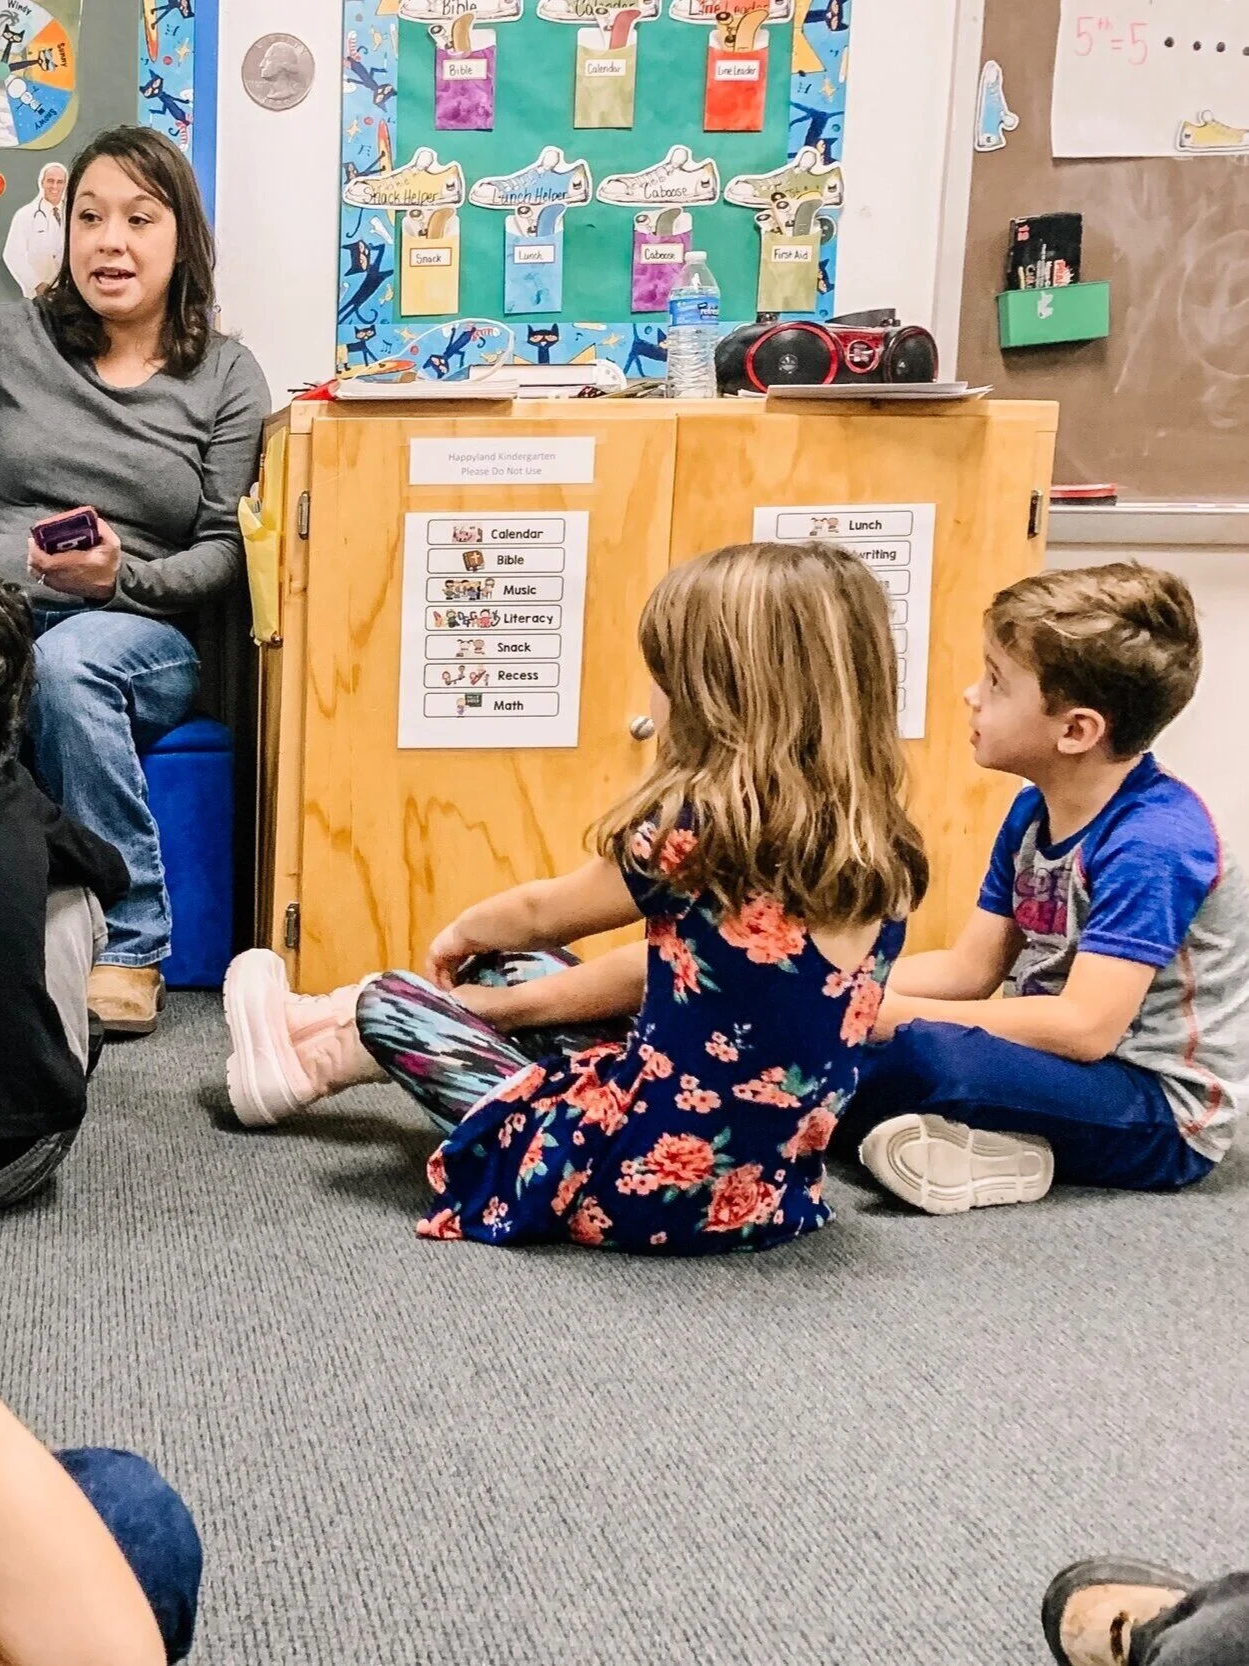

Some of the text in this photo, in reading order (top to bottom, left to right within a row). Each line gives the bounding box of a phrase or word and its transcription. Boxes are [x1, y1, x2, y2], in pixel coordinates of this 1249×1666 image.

[7, 0, 32, 16] Windy
[57, 42, 68, 68] Sunny
[449, 64, 473, 77] Bible
[587, 62, 622, 74] Calendar
[34, 108, 58, 130] Snowy
[363, 187, 439, 206] Snack Helper
[493, 187, 568, 204] Lunch Helper
[644, 182, 688, 199] Caboose
[415, 253, 442, 265] Snack
[518, 251, 543, 261] Lunch
[644, 248, 676, 260] Caboose
[774, 249, 809, 260] First Aid
[448, 451, 556, 463] Happyland Kindergarten
[461, 466, 542, 476] Please Do Not Use
[849, 519, 883, 531] Lunch
[491, 529, 544, 540] Calendar
[497, 554, 525, 566] Bible
[503, 585, 537, 595] Music
[503, 613, 554, 625] Literacy
[497, 642, 532, 653] Snack
[497, 670, 539, 681] Recess
[493, 701, 524, 711] Math
